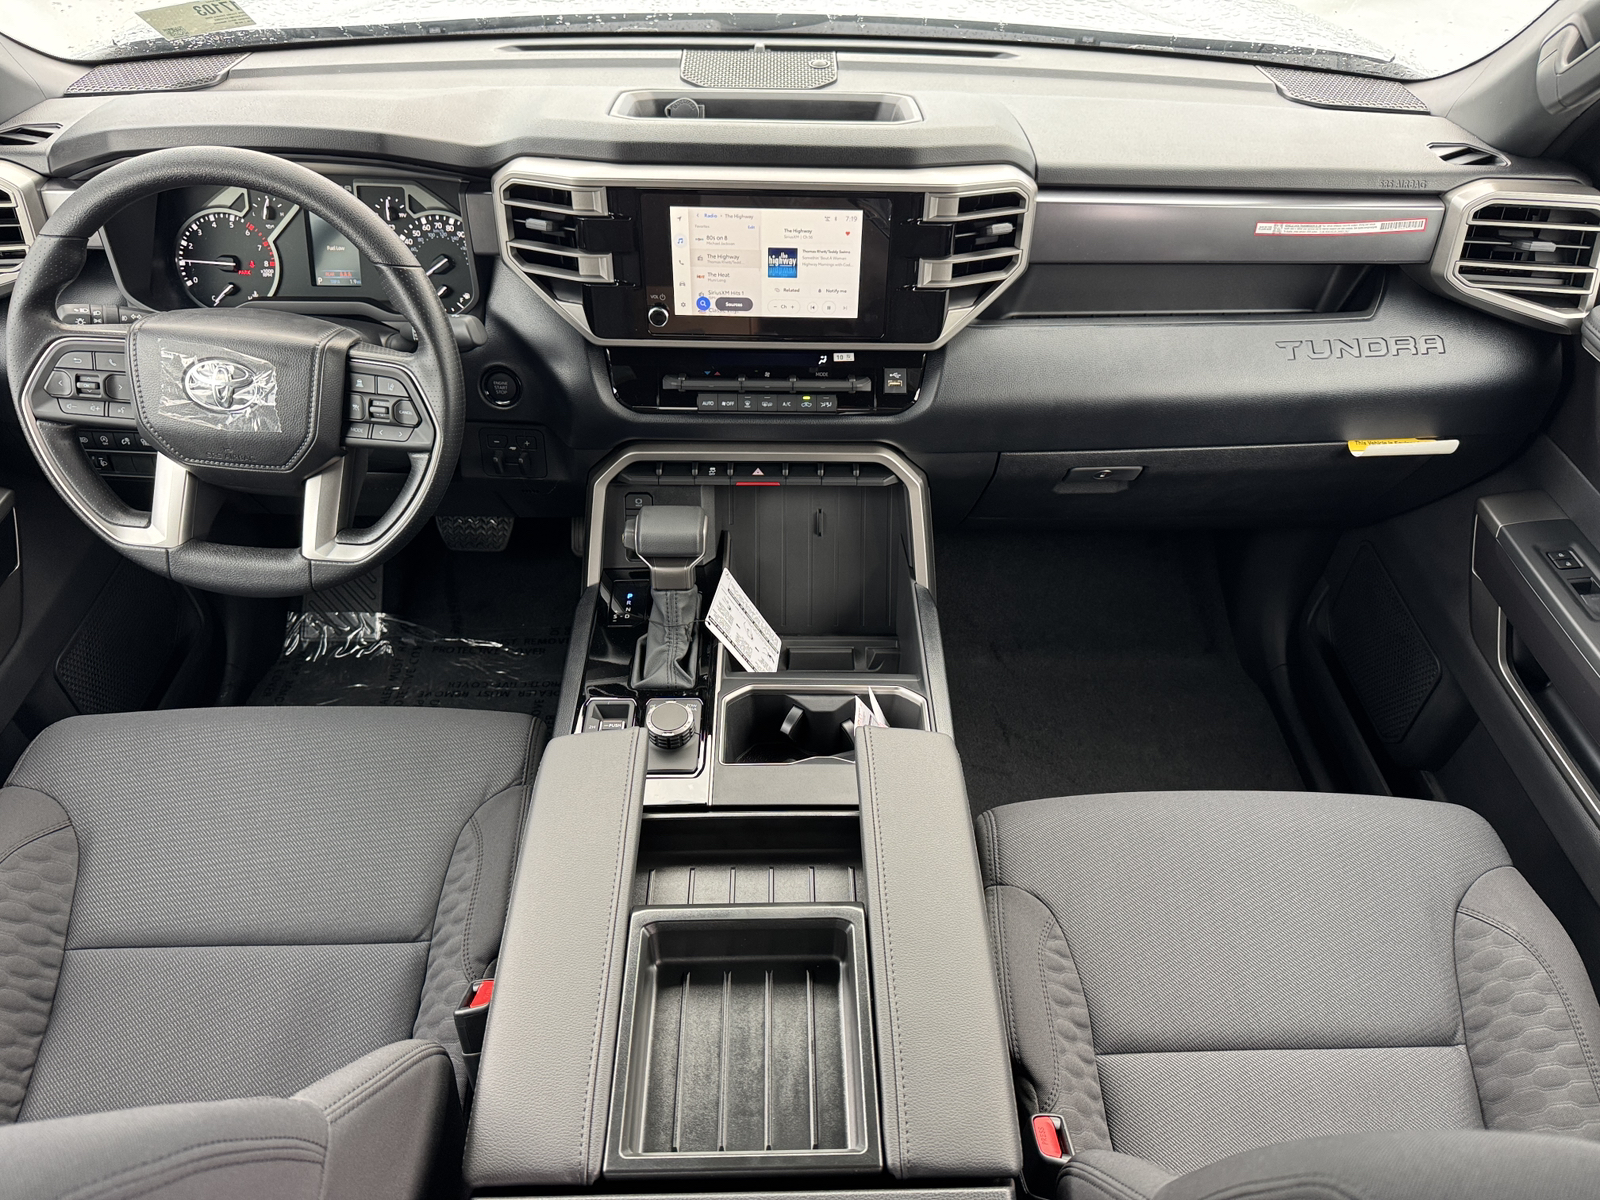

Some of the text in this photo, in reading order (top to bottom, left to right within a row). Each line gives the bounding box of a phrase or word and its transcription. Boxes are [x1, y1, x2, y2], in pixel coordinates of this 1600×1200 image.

[768, 255, 796, 266] highway
[1274, 334, 1446, 361] TUNDRA
[1038, 1126, 1048, 1145] PRESS
